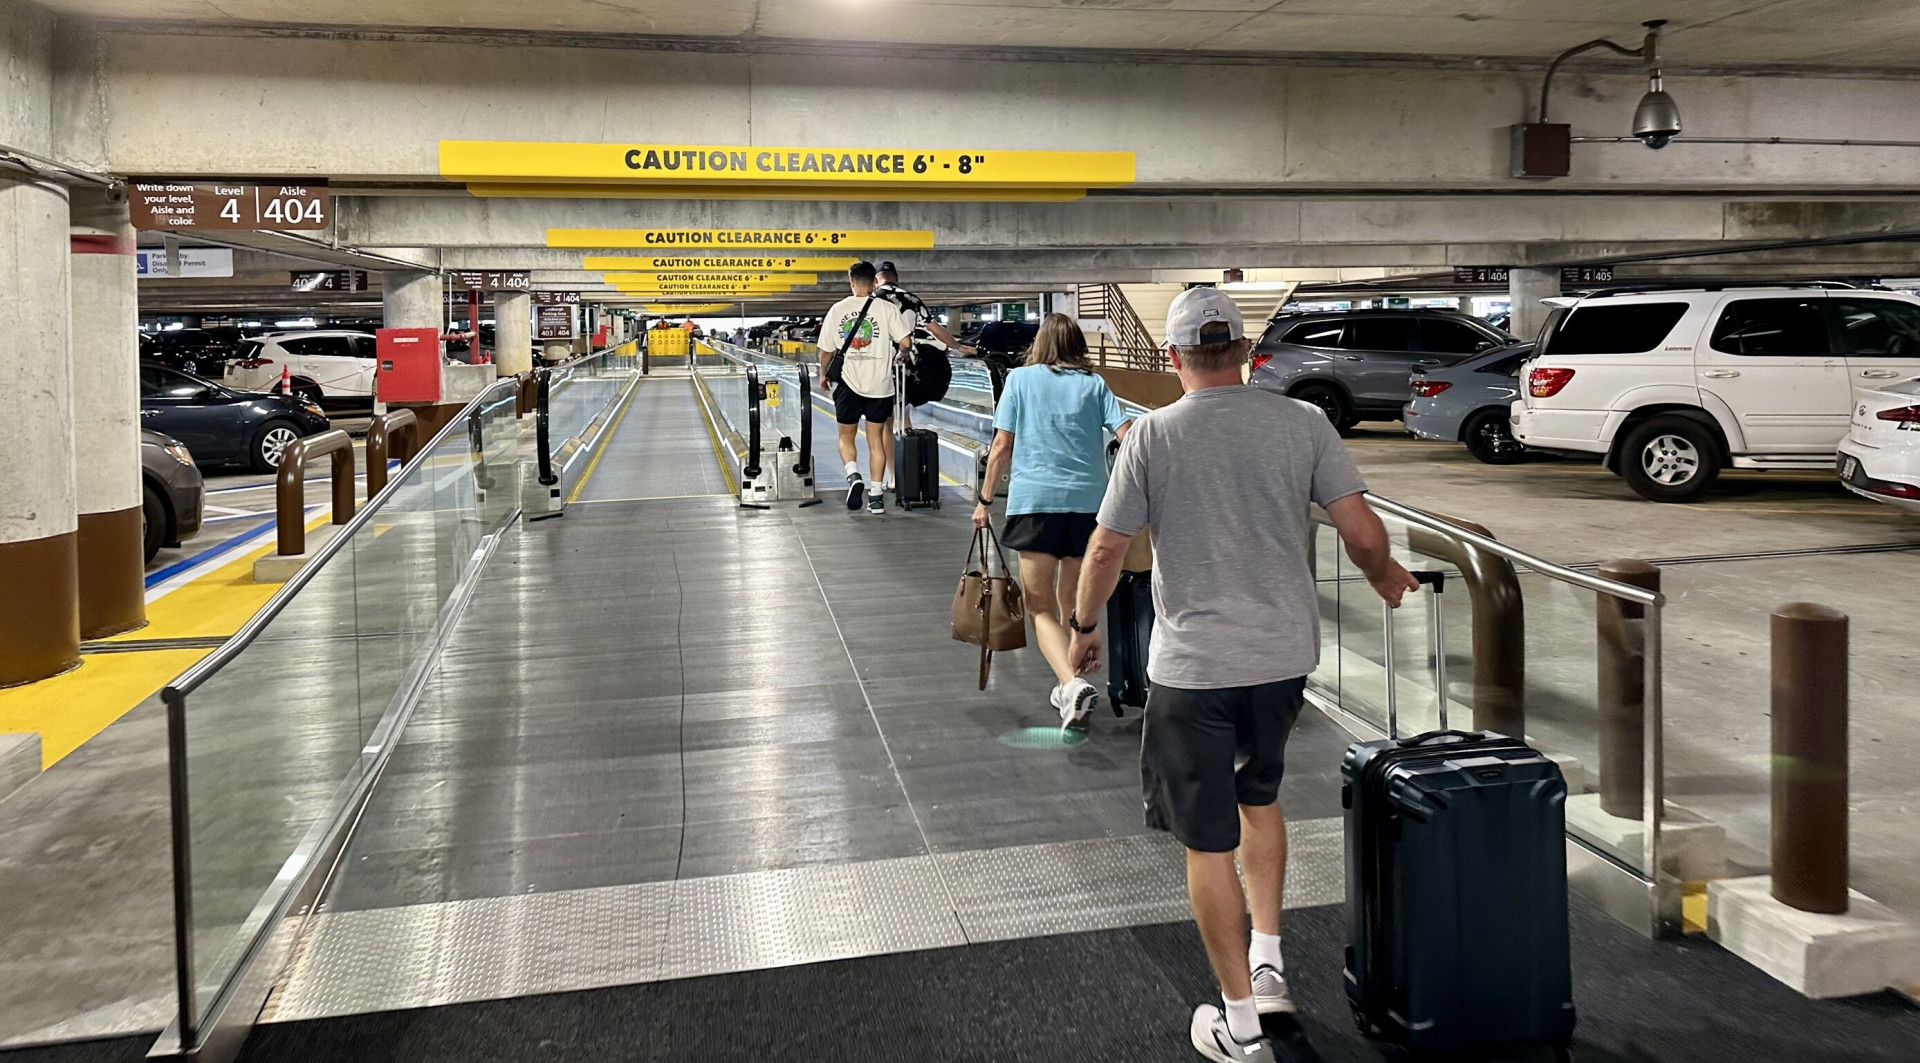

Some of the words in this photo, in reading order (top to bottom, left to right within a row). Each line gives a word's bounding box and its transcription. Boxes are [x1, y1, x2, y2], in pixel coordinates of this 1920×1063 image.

[624, 149, 747, 171] CAUTION
[755, 151, 905, 173] CLEARANCE
[912, 154, 935, 174] 6'
[958, 155, 985, 174] 8"
[165, 184, 194, 192] down
[214, 186, 244, 196] Level
[279, 186, 307, 196] Aisle
[144, 196, 167, 204] your
[168, 194, 194, 204] level,
[150, 206, 174, 214] Aisle
[175, 206, 195, 214] and
[220, 198, 241, 224] 4
[263, 198, 324, 224] 404
[168, 217, 195, 226] color.
[645, 232, 713, 244] CAUTION
[717, 232, 800, 244] CLEARANCE
[804, 232, 818, 244] 6'
[830, 232, 847, 244] 8"
[652, 258, 700, 267] CAUTION
[703, 258, 763, 268] CLEARANCE
[766, 258, 776, 268] 6'
[784, 258, 797, 268] 8"
[1478, 272, 1485, 281] 4
[1490, 272, 1508, 281] 404
[1584, 272, 1590, 281] 4
[1596, 272, 1612, 281] 405
[324, 278, 334, 289] 4
[490, 277, 499, 288] 4
[506, 277, 530, 288] 404
